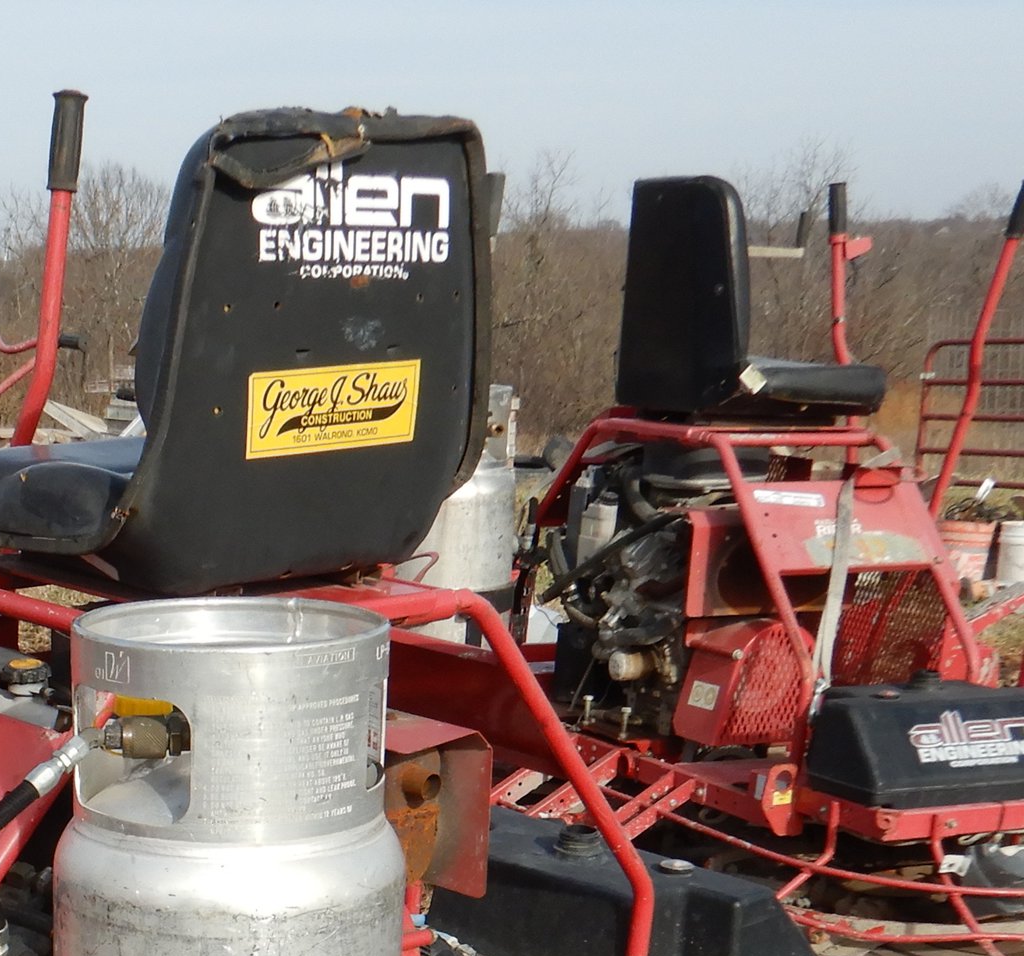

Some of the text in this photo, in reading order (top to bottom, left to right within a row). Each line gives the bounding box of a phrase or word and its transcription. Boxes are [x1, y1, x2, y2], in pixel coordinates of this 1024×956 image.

[252, 161, 450, 229] allen
[258, 228, 450, 264] ENGINEERING
[259, 378, 329, 440] George
[347, 372, 409, 407] Shaw
[300, 408, 374, 427] CONSTRUCTION
[356, 426, 378, 436] KCMO
